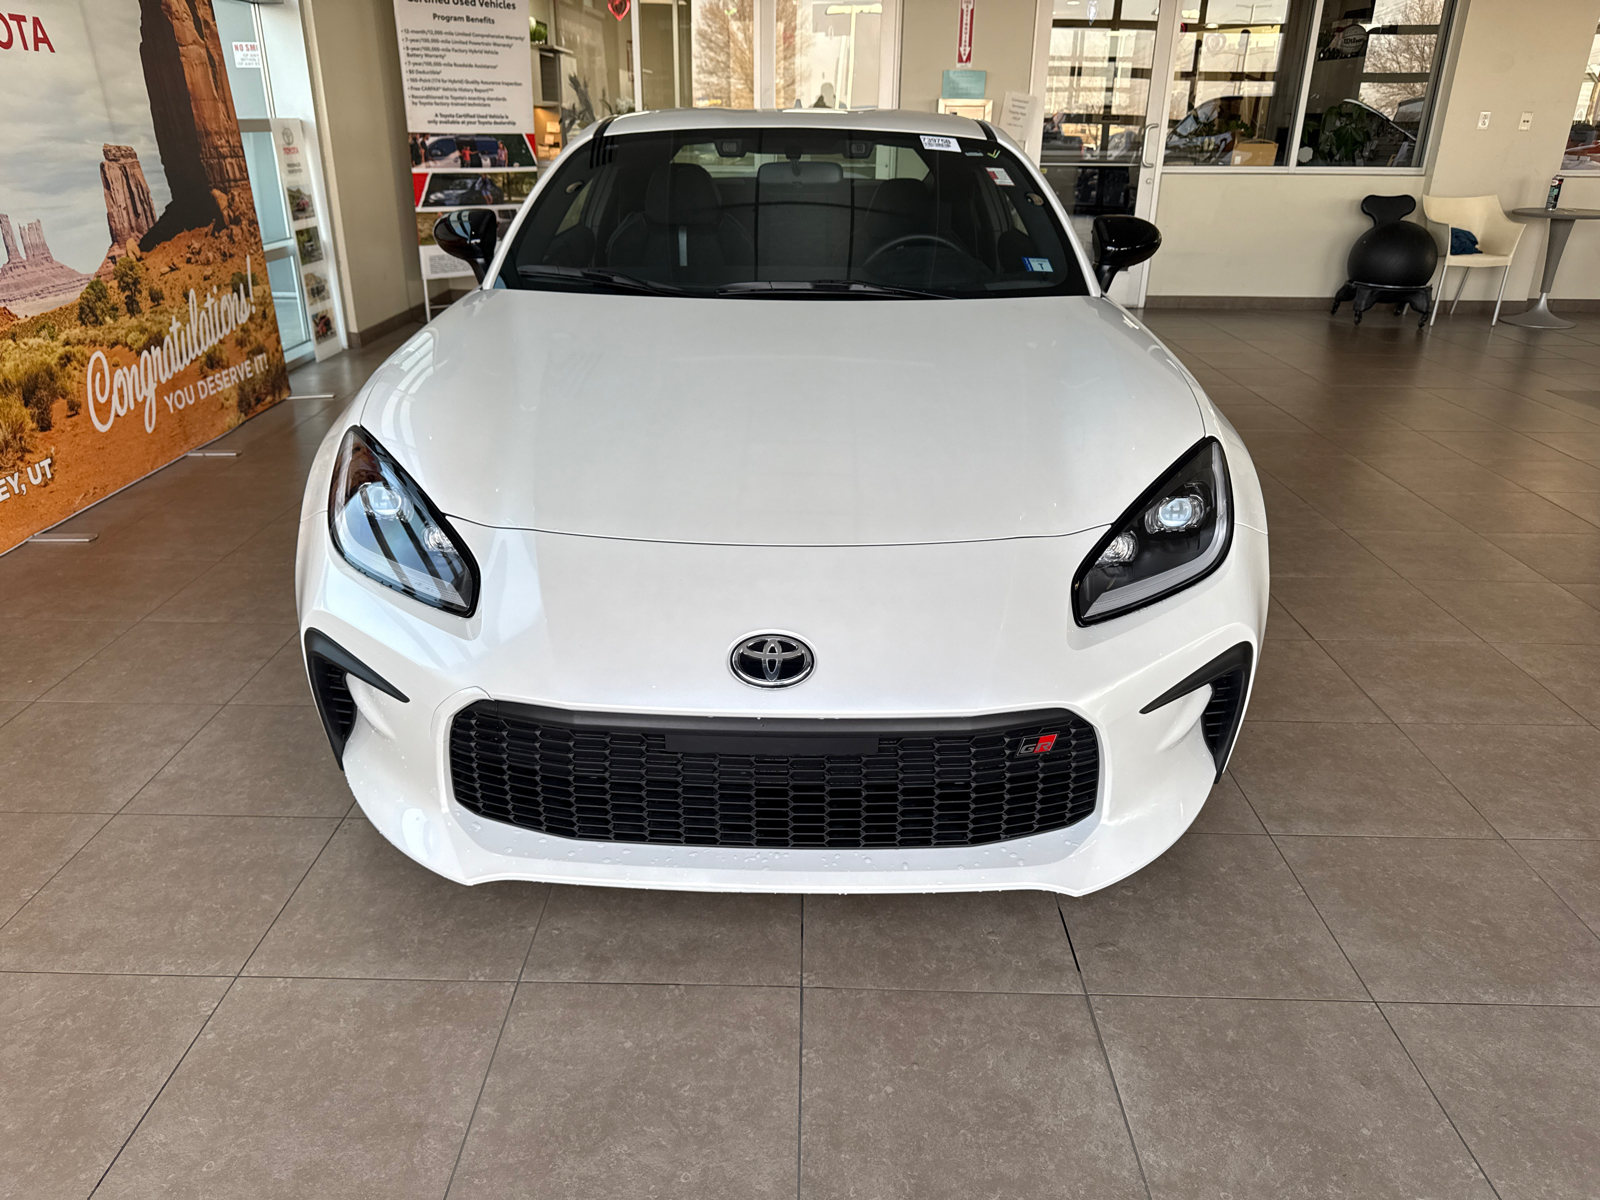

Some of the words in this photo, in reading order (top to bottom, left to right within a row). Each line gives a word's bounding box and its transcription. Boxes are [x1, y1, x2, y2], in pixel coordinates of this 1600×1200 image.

[478, 0, 516, 10] Vehicles
[432, 13, 465, 23] Program
[466, 15, 495, 25] Benefits
[245, 44, 258, 52] SM
[87, 255, 256, 434] Congratulations!
[164, 384, 195, 414] YOU
[197, 360, 253, 400] DESERVE
[254, 352, 269, 375] IT!
[0, 471, 27, 502] EY,
[26, 457, 52, 485] UT
[1020, 742, 1052, 753] GR
